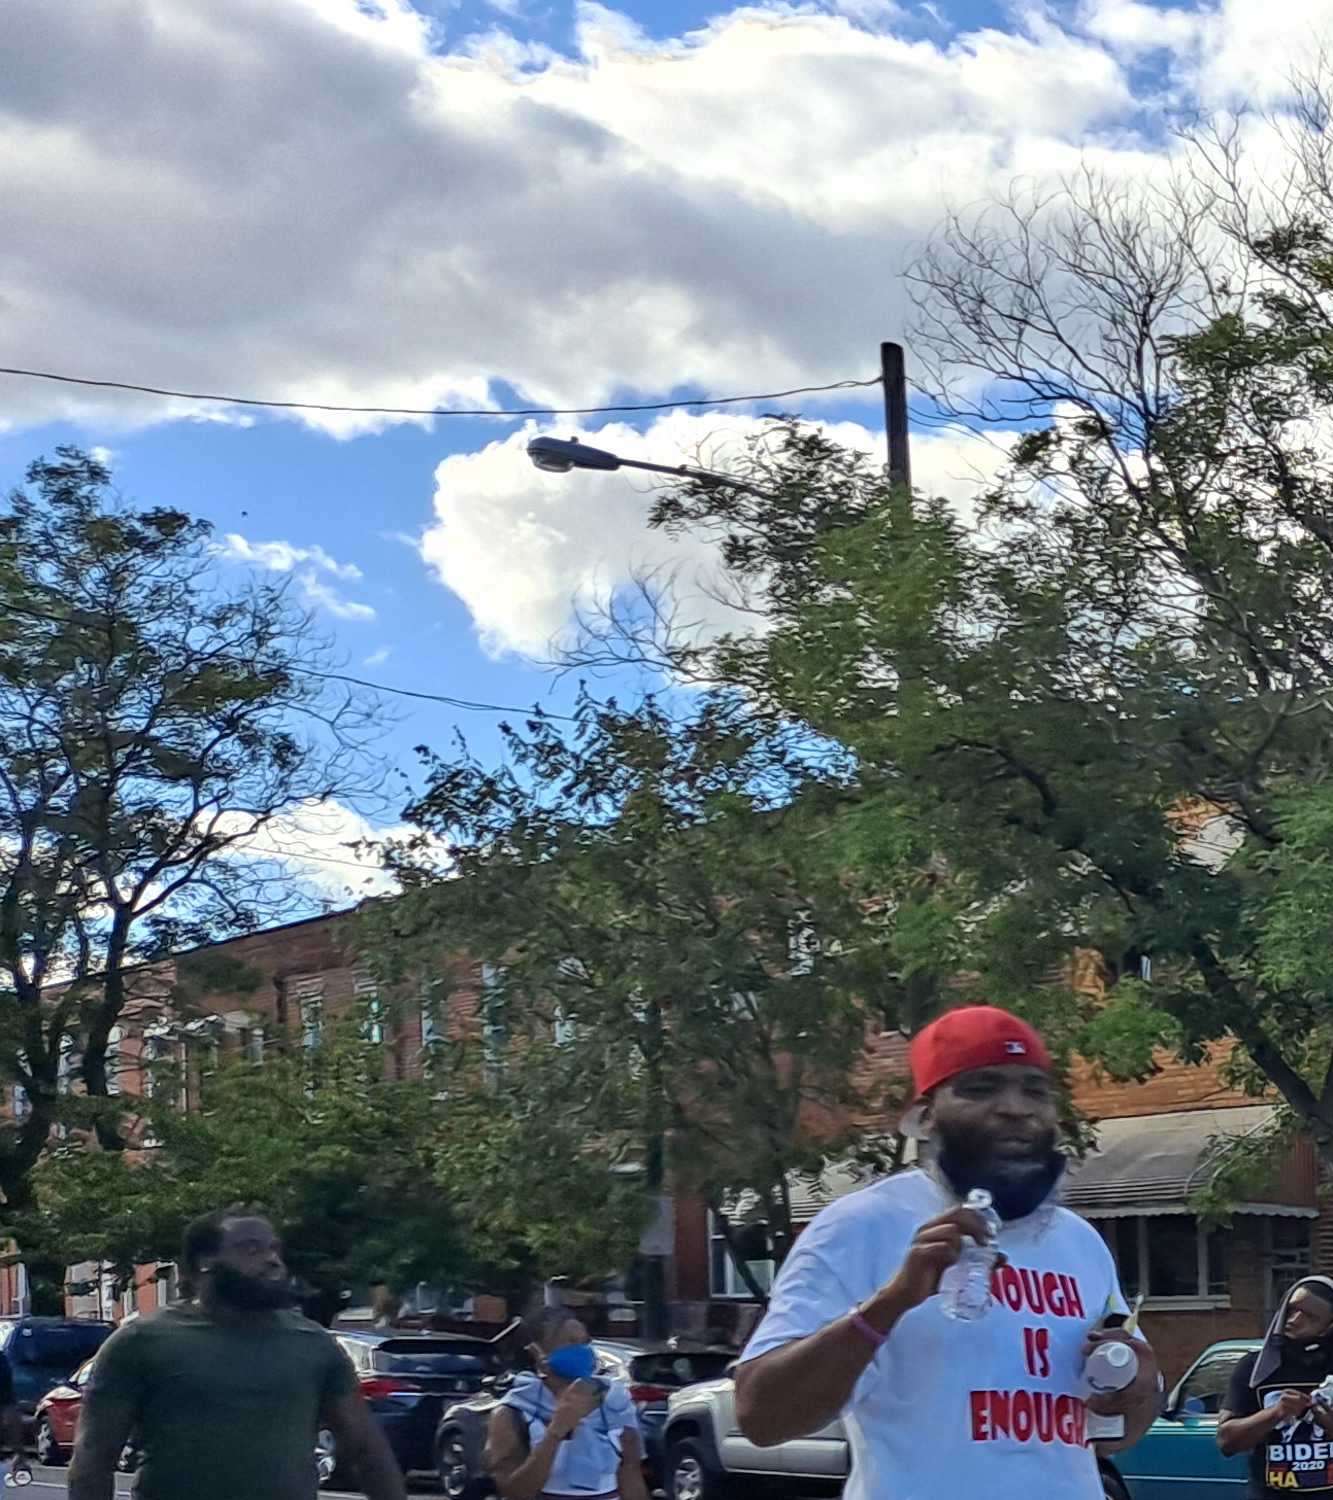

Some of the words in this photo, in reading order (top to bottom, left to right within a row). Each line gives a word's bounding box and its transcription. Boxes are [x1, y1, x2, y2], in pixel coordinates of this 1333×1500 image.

[990, 1264, 1086, 1319] NOUGH
[1023, 1327, 1050, 1378] IS
[1291, 1461, 1326, 1471] 2020
